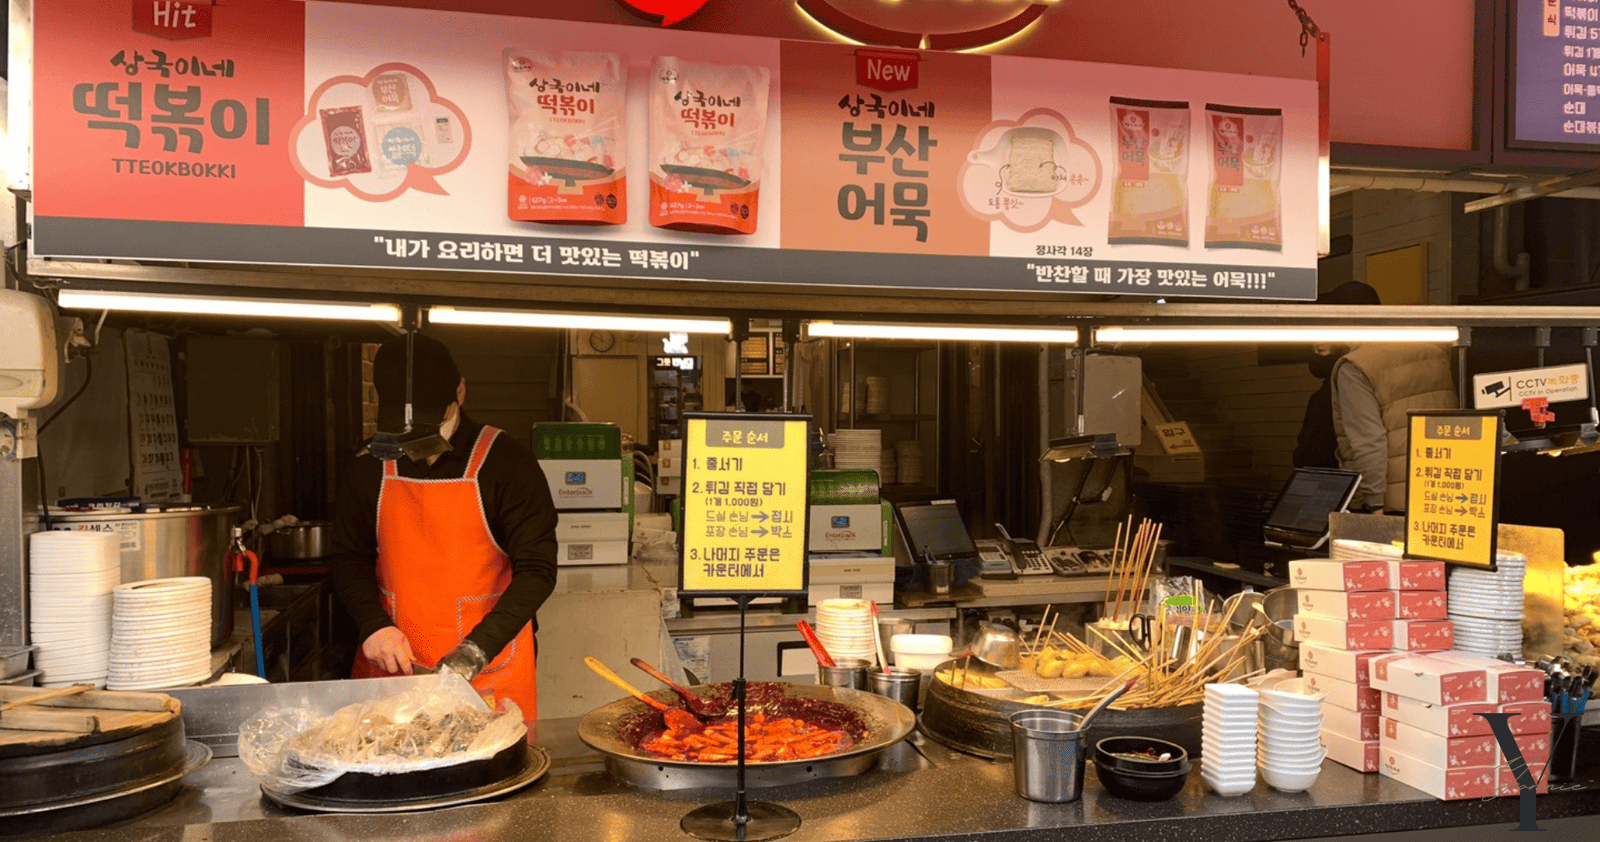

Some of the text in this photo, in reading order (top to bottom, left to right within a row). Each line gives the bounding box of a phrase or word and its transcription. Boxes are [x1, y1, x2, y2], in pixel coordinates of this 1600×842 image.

[153, 1, 196, 28] Hit
[1564, 6, 1599, 21] 떡볶이
[1564, 25, 1600, 40] 튀김 5
[1563, 45, 1584, 58] 튀김
[110, 50, 235, 78] 상국이네
[867, 58, 911, 82] New
[1563, 63, 1600, 77] 어묵 4
[529, 77, 600, 93] 상국이네
[537, 94, 594, 116] 떡볶이
[674, 89, 742, 108] 상국이네
[838, 93, 935, 119] 상국이네
[1563, 101, 1586, 115] 순대
[73, 81, 270, 154] 떡볶이
[681, 107, 735, 130] 떡볶이
[1563, 120, 1600, 135] 순대볶
[838, 121, 938, 178] 부산
[111, 158, 236, 178] TTEOKBOKKI
[837, 181, 931, 243] 어묵
[373, 236, 700, 270] "내가 요리하면 더 맛있는 떡볶이"
[1036, 245, 1094, 257] 정사각 14장
[1027, 263, 1276, 290] "반찬할 때 가장 맛있는 어묵!!!"
[1545, 386, 1578, 395] Operation
[722, 430, 768, 445] 주문 순서
[1436, 425, 1470, 437] 주문 순서
[1416, 447, 1452, 459] 1. 줄서기
[692, 457, 743, 471] 1. 줄서기
[1425, 467, 1442, 479] 튀김
[1444, 468, 1461, 480] 직접
[1464, 469, 1482, 481] 담기
[692, 481, 786, 496] 2. 튀김 직접 담기
[705, 497, 722, 506] (1개
[1470, 493, 1487, 505] 접시
[706, 510, 793, 523] 드실 손님 접시
[705, 525, 726, 538] 포장
[729, 526, 748, 537] 손님
[1422, 521, 1447, 534] 나머지
[1449, 524, 1476, 538] 주문은
[1422, 534, 1464, 550] 카운터에서
[690, 547, 780, 561] 3. 나머지 주문은
[703, 563, 765, 577] 카운터에서
